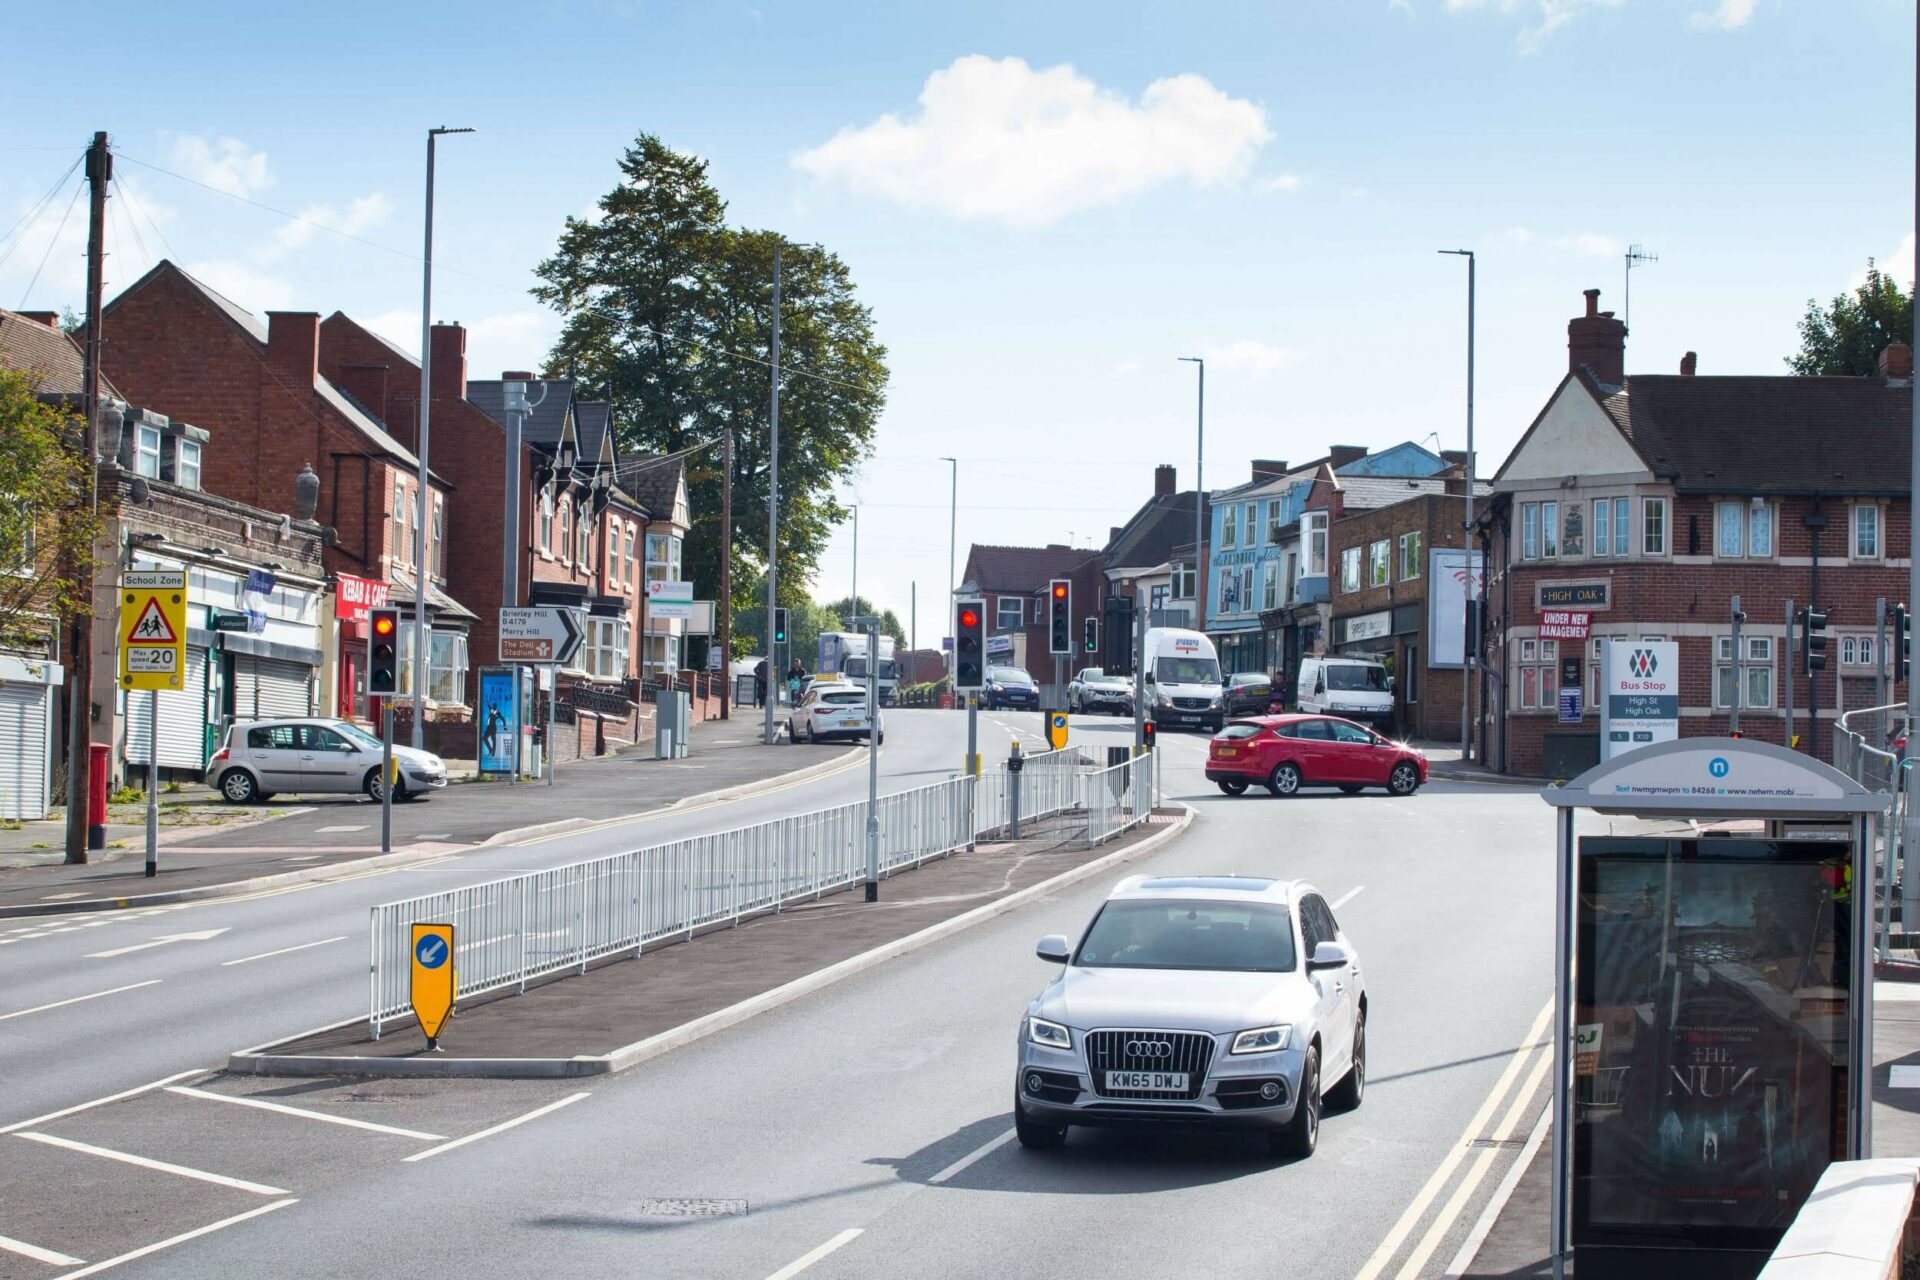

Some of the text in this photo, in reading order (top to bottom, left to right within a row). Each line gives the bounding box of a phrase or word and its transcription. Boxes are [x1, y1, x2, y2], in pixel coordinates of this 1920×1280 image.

[126, 576, 182, 585] School Zone
[342, 579, 364, 603] KEBAB
[364, 583, 370, 605] &
[1548, 590, 1597, 600] HIGH OAK
[502, 610, 531, 618] Brierley
[1544, 612, 1588, 625] UNDER NEW
[502, 628, 523, 636] Merry
[503, 640, 534, 649] The Dell
[130, 656, 149, 664] speed
[150, 650, 173, 664] 20
[1621, 681, 1666, 691] Bus Stop
[1628, 697, 1647, 706] High
[1625, 707, 1661, 716] High Oak
[1682, 786, 1690, 794] to
[1691, 786, 1716, 794] 84268
[1727, 787, 1795, 796] www.netwm.mobi
[1112, 1073, 1183, 1088] KW65 DWJ
[1665, 1065, 1759, 1098] NUN
